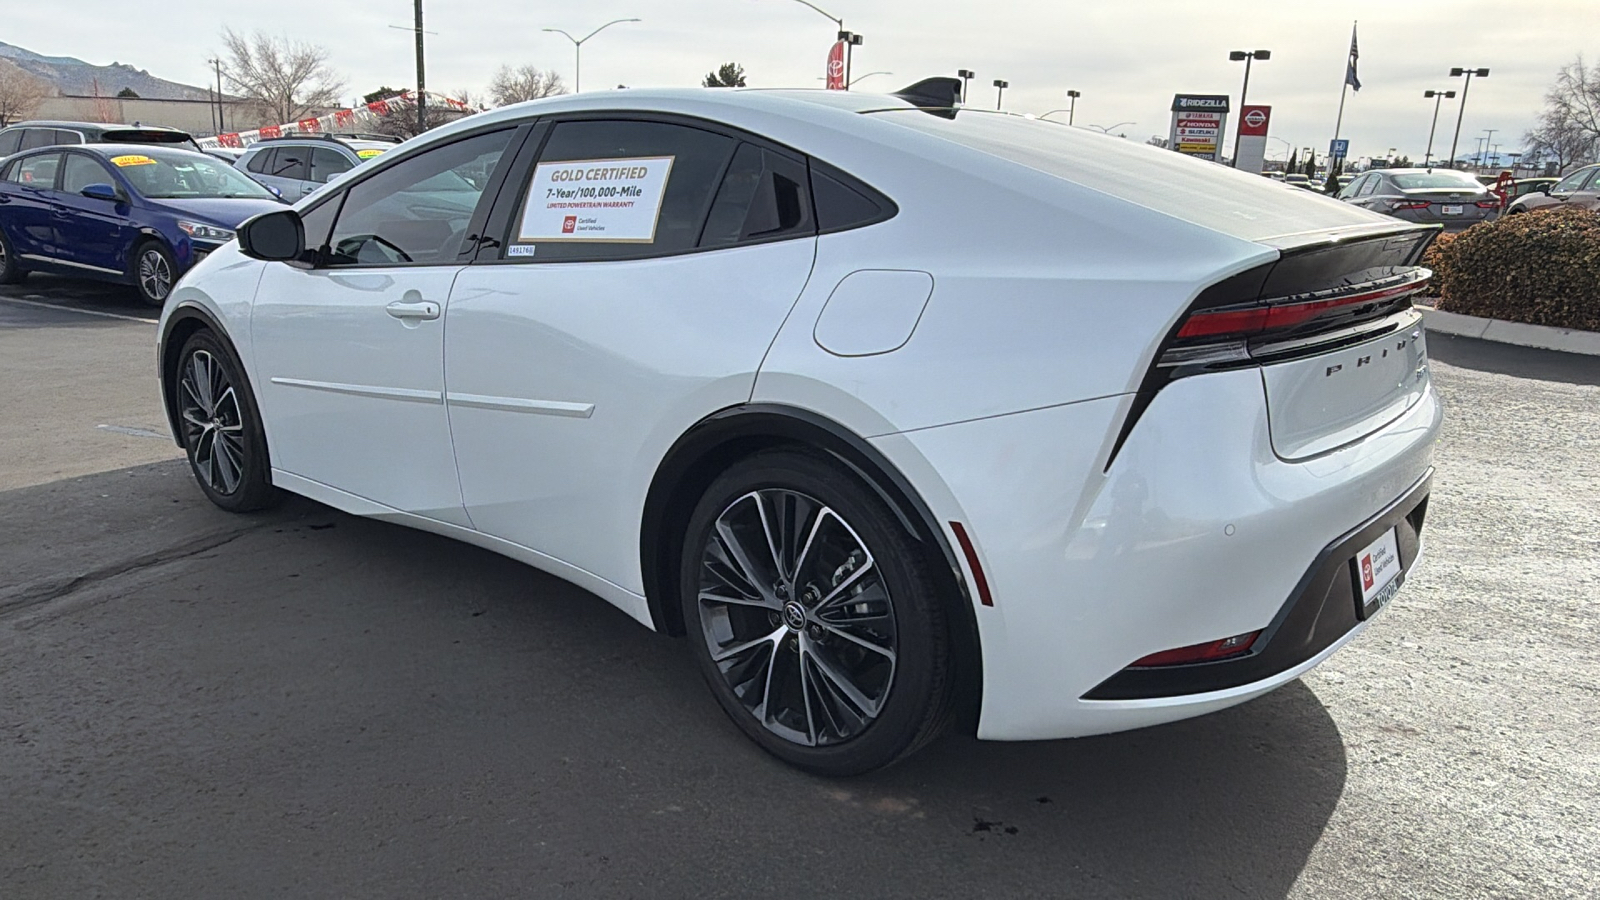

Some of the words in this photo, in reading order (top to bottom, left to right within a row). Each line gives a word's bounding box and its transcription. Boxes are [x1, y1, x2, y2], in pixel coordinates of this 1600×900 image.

[1187, 99, 1227, 107] RIDEZILLA
[551, 169, 584, 182] GOLD
[586, 167, 648, 181] CERTIFIED
[546, 186, 642, 199] 7-Year/100,000-Mile
[1377, 580, 1398, 607] TOYOTA
